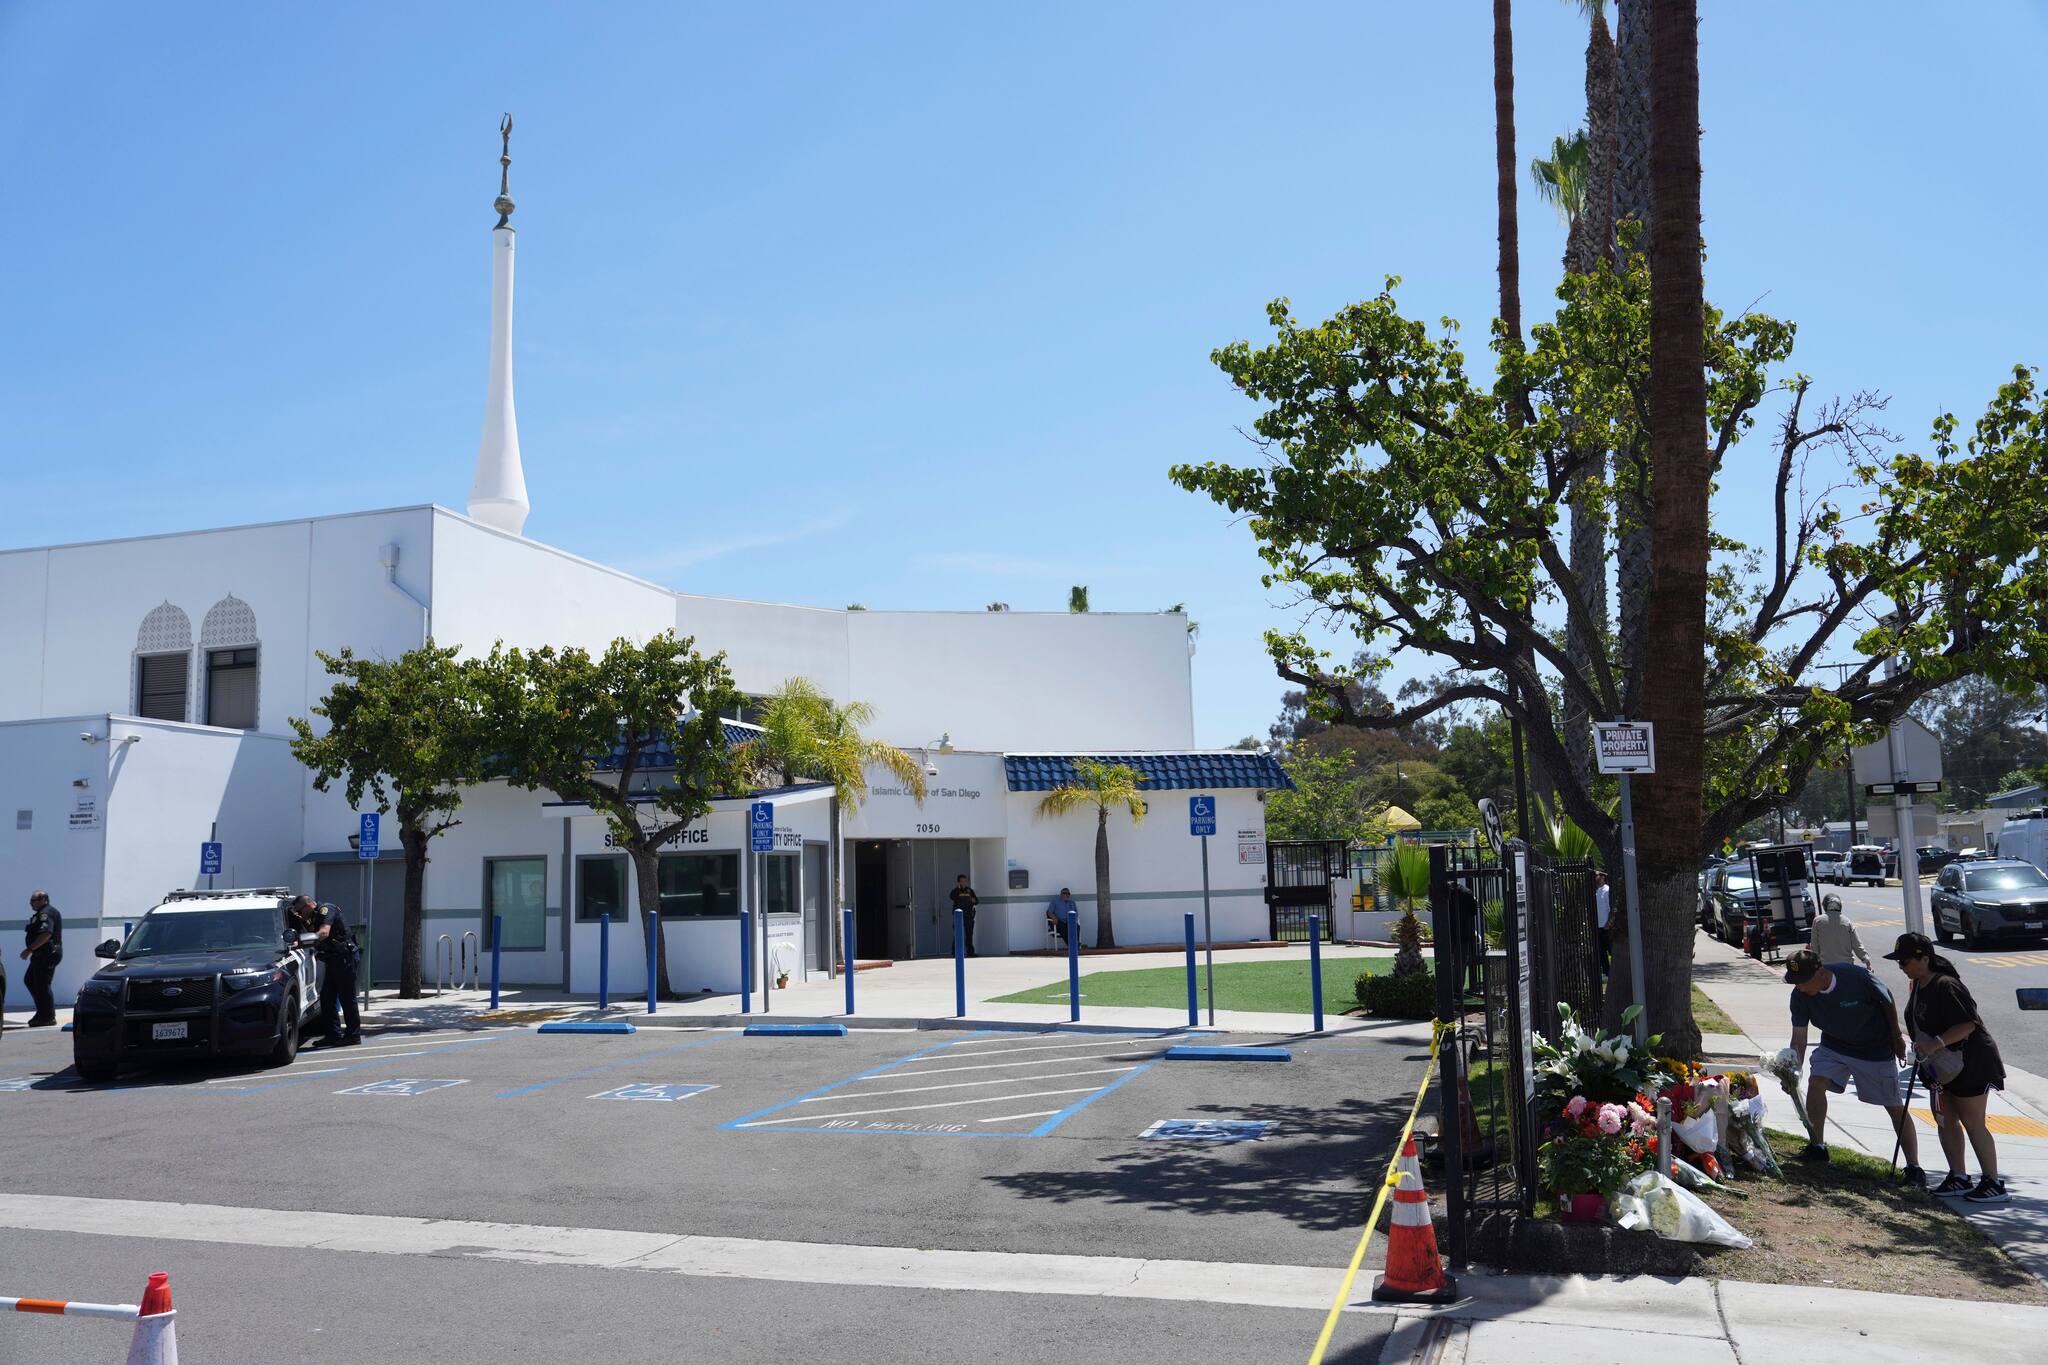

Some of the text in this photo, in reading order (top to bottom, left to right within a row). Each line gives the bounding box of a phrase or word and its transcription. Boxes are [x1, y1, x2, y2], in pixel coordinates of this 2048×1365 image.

[1605, 730, 1643, 740] PRIVATE
[1602, 740, 1647, 751] PROPERTY
[872, 786, 901, 796] Islamic
[931, 788, 939, 797] of
[941, 788, 957, 798] San
[959, 789, 981, 800] Diego
[752, 822, 773, 830] PARKING
[1191, 817, 1216, 825] PARKING
[916, 824, 940, 833] 7050
[1195, 825, 1211, 834] ONLY
[667, 830, 709, 845] OFFICE
[784, 833, 801, 847] OFFICE
[819, 1119, 967, 1132] NO PARKING
